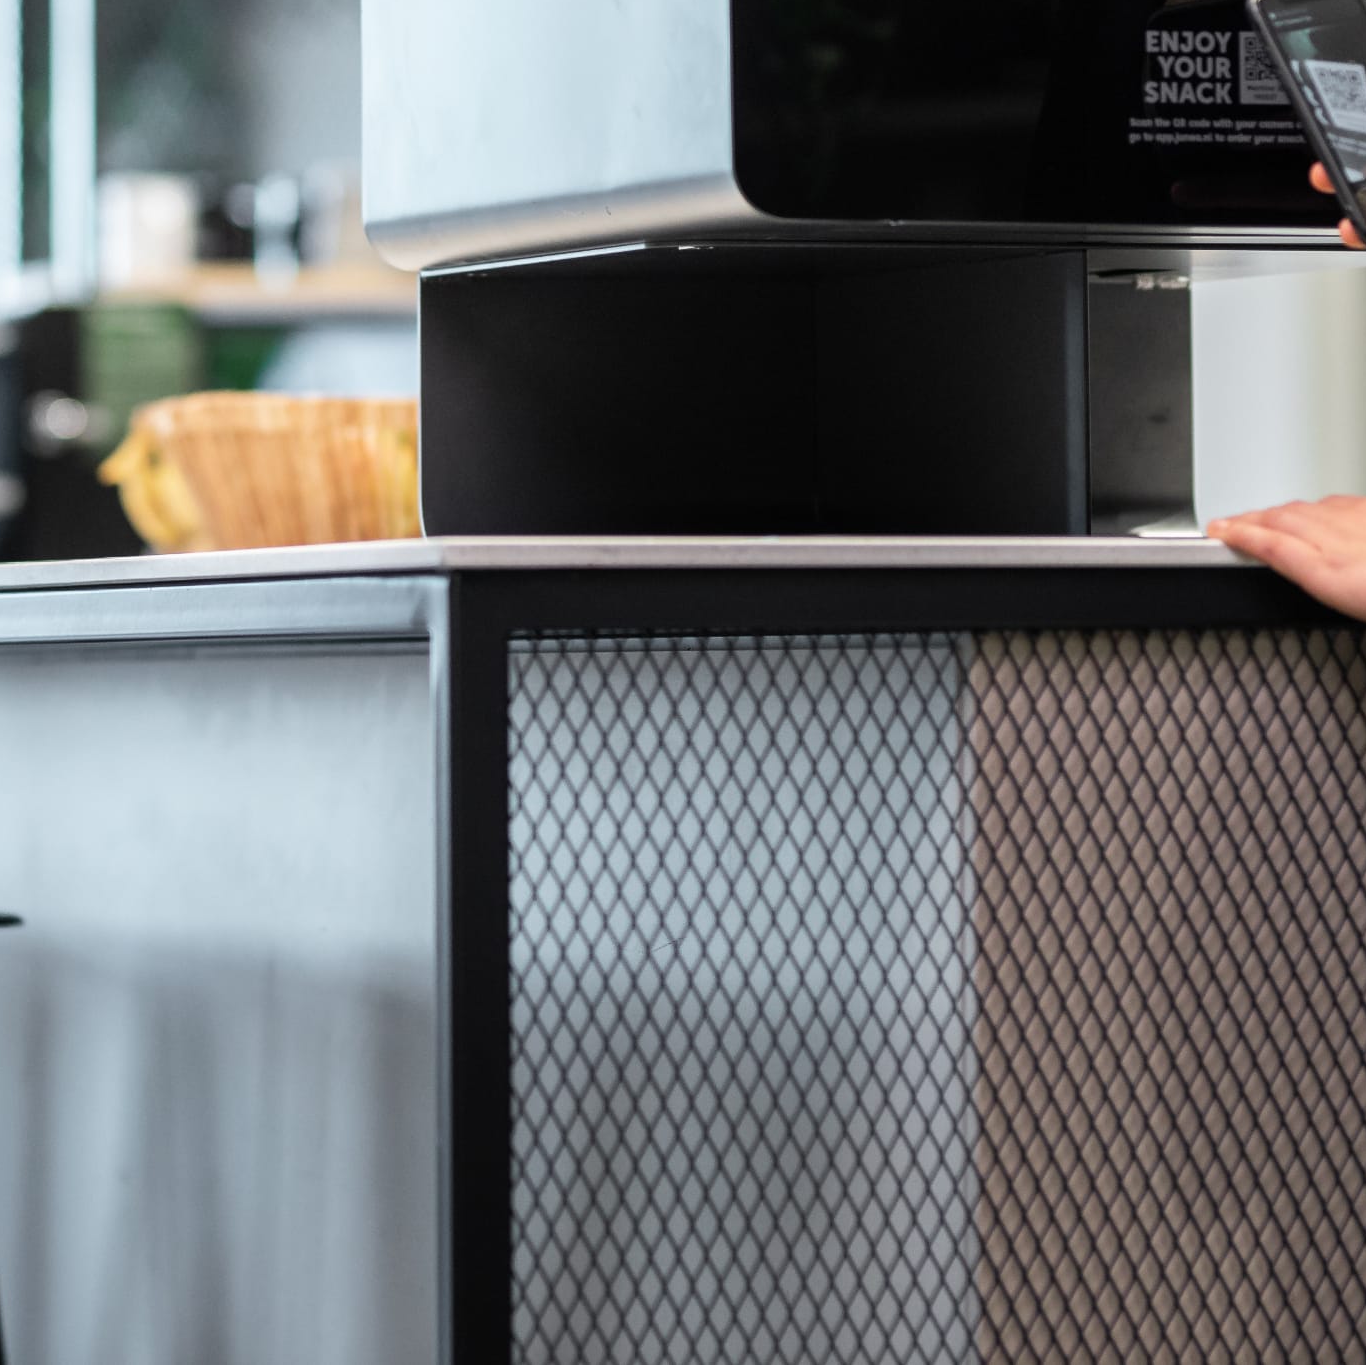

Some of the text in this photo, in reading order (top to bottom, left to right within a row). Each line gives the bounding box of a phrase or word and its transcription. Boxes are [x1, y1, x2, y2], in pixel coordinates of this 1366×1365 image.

[1145, 30, 1233, 53] ENJOY
[1157, 56, 1233, 79] YOUR
[1144, 81, 1233, 104] SNACK
